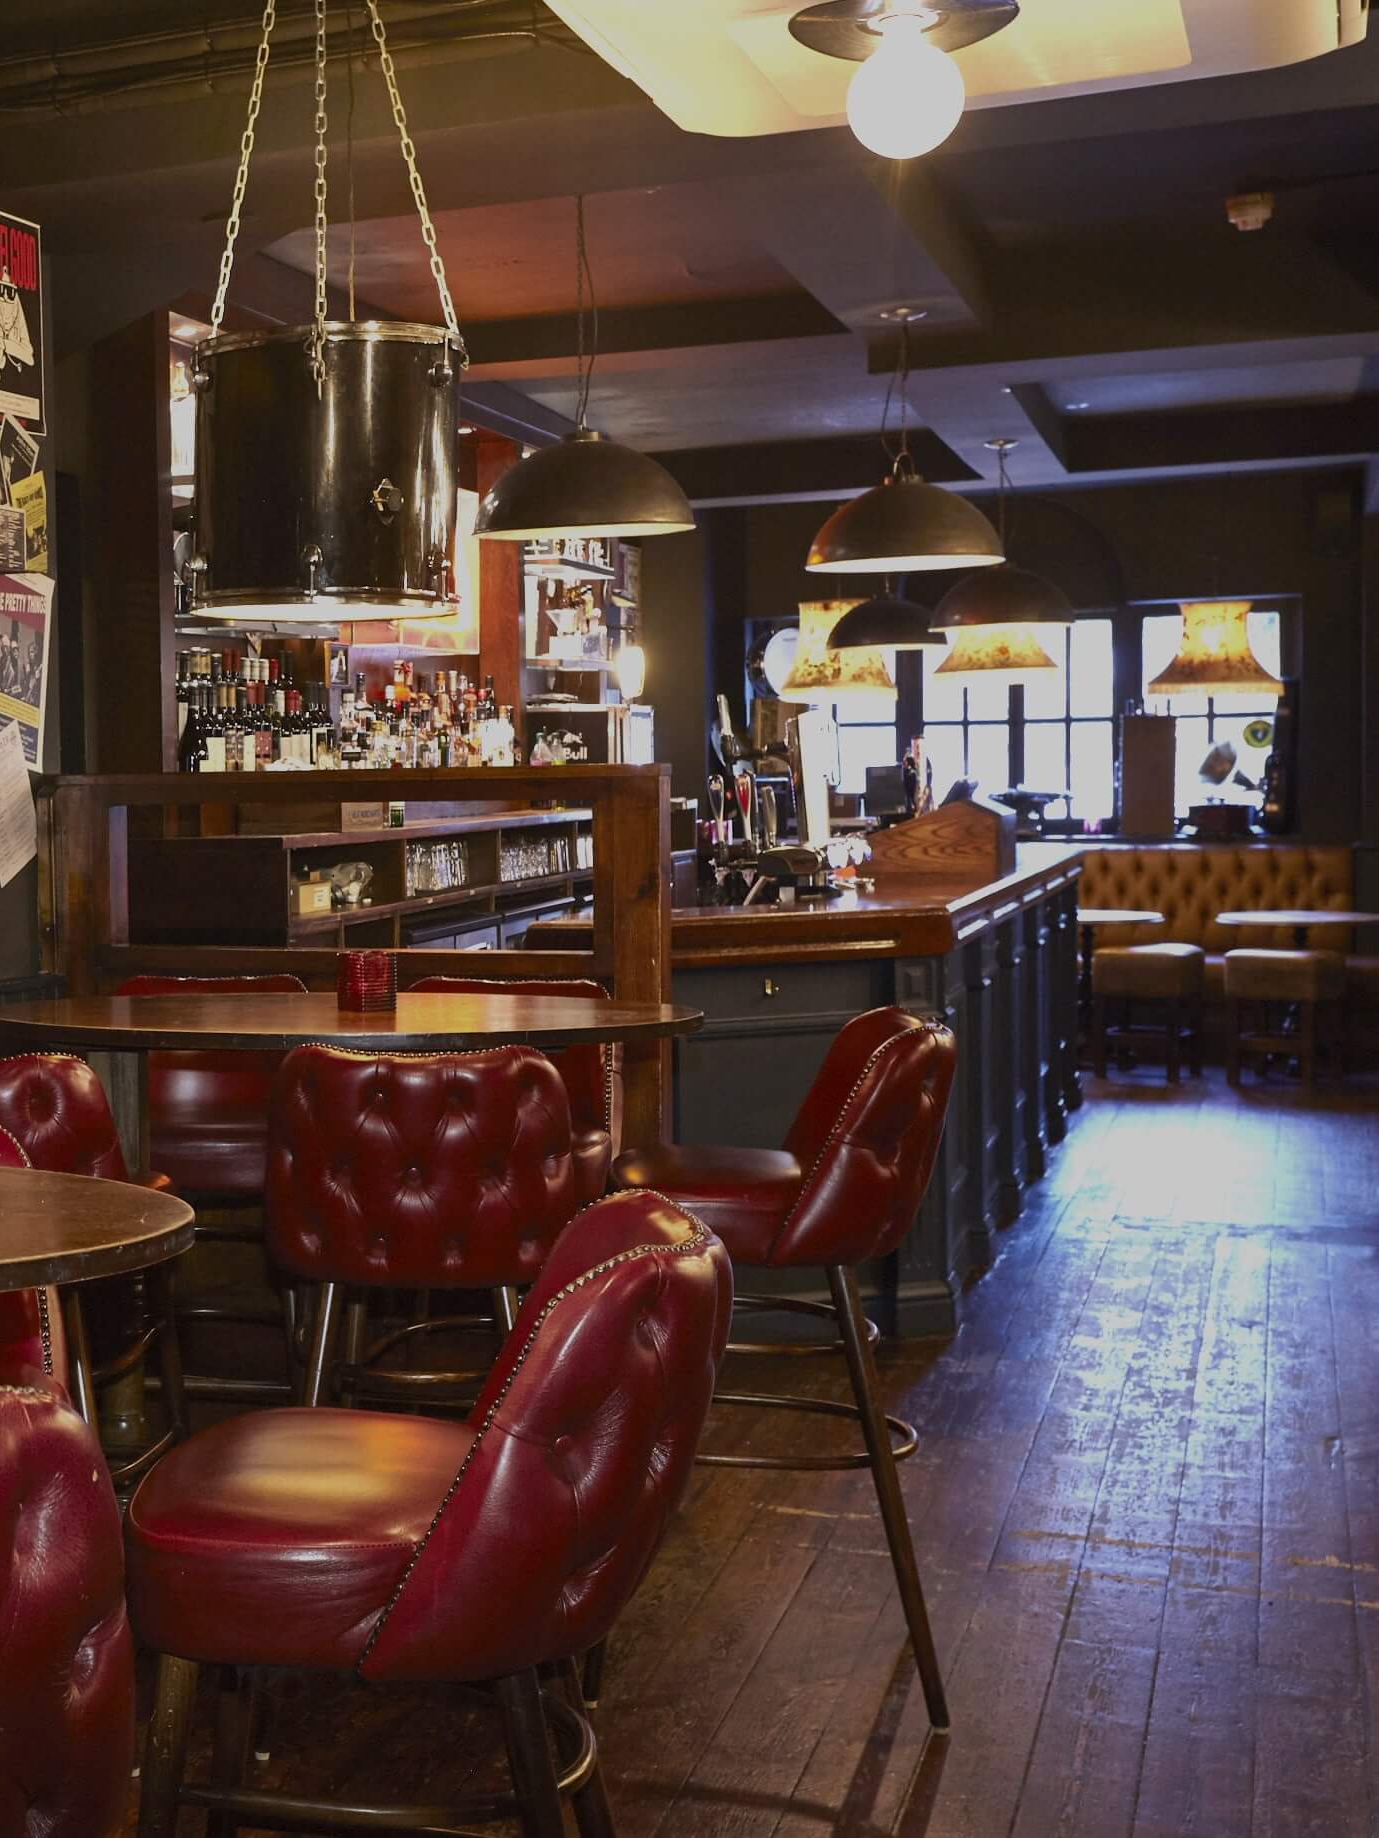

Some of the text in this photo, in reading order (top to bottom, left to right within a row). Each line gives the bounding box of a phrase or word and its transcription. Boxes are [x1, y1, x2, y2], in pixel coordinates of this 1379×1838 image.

[5, 592, 26, 613] PRETTY
[27, 597, 46, 614] THINGS
[565, 747, 588, 760] Bull
